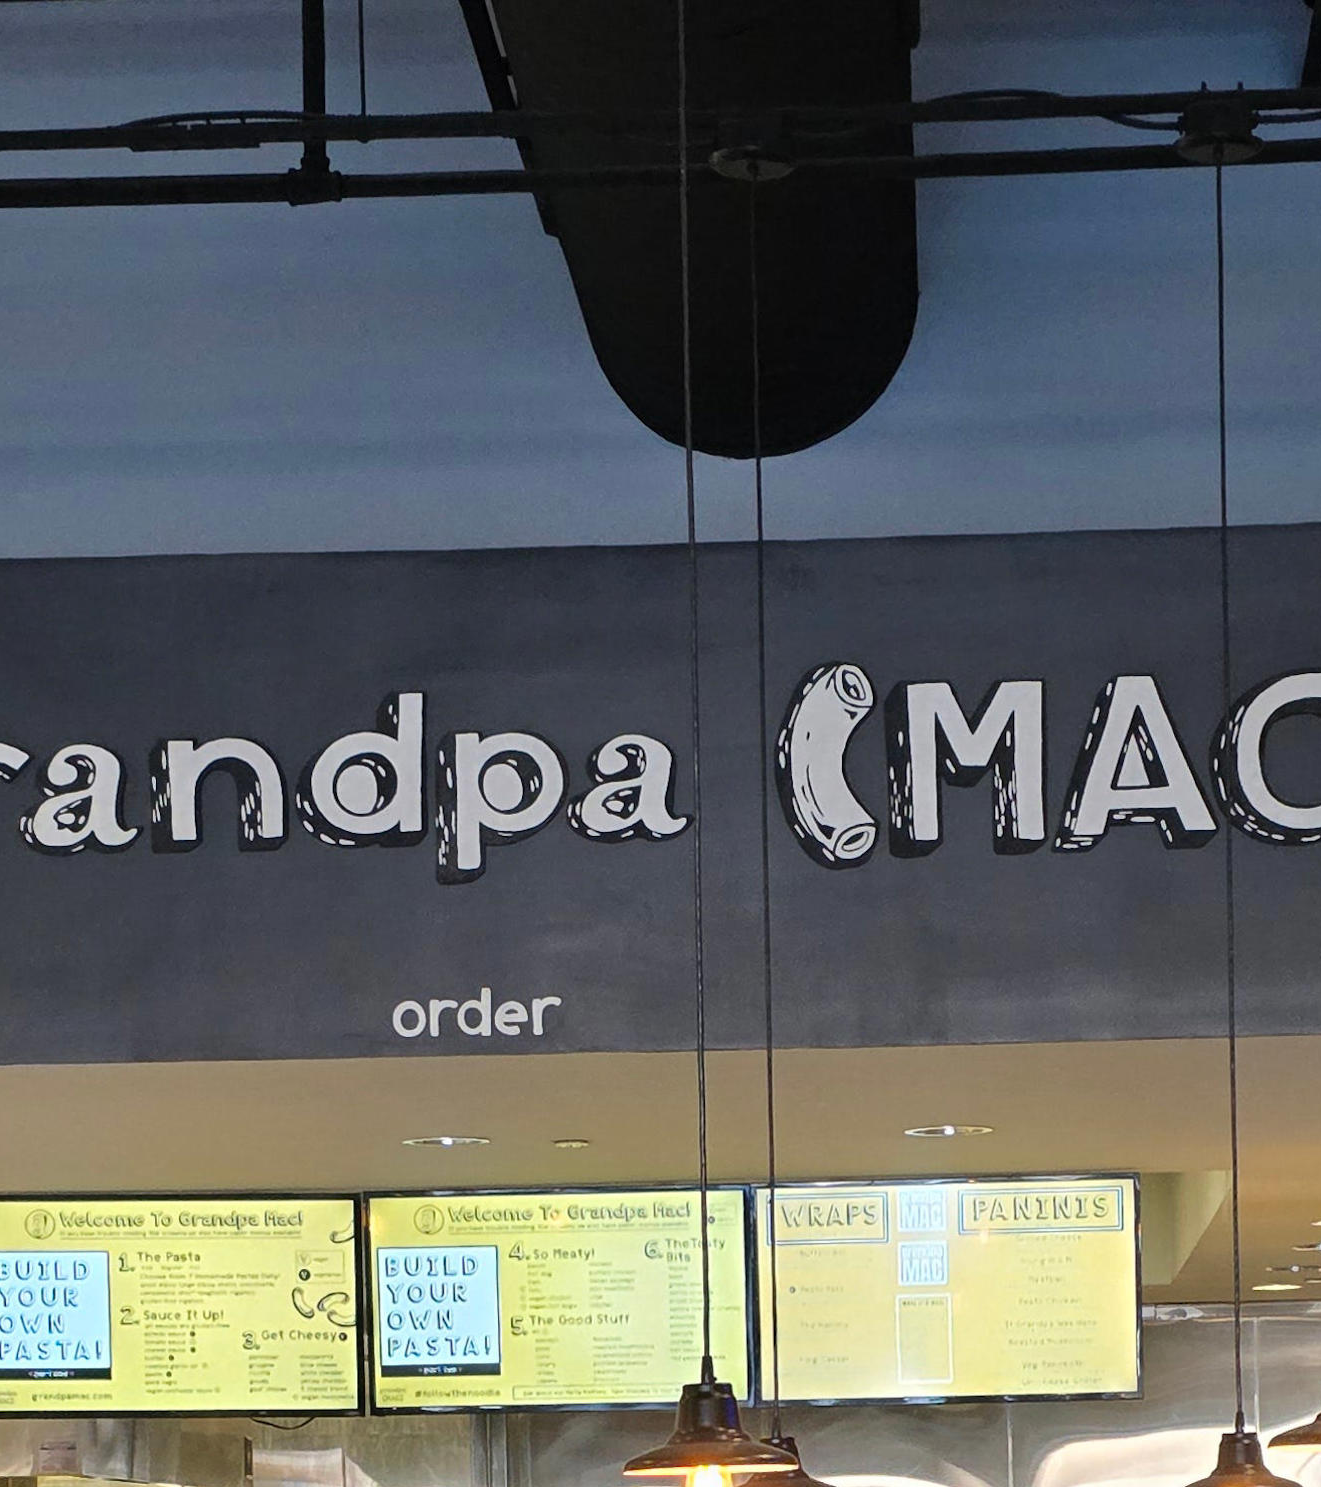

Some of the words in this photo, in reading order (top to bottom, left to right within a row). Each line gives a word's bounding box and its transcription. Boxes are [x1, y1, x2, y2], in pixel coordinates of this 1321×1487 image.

[392, 988, 563, 1039] order
[447, 1204, 533, 1223] Welcome
[567, 1204, 648, 1222] Grandpa
[781, 1202, 878, 1228] WRAPS
[972, 1195, 1109, 1221] PANINIS
[59, 1211, 146, 1228] Welcome
[151, 1212, 174, 1227] To
[178, 1211, 260, 1230] Grandpa
[665, 1239, 689, 1249] The
[138, 1252, 161, 1262] The
[166, 1252, 201, 1263] Pasta
[533, 1248, 548, 1259] So
[553, 1248, 595, 1261] Meaty!
[385, 1255, 479, 1277] BUILD
[902, 1258, 944, 1282] MAC
[386, 1282, 468, 1304] YOUR
[143, 1310, 181, 1320] Sauce
[187, 1310, 198, 1320] It
[203, 1310, 225, 1322] Up!
[387, 1309, 454, 1330] OWN
[529, 1315, 552, 1326] The
[559, 1315, 593, 1325] Good
[597, 1314, 631, 1325] Stuff
[261, 1330, 284, 1340] Get
[289, 1330, 337, 1342] Cheesy
[0, 1340, 102, 1360] PASTA!
[388, 1335, 491, 1358] PASTA!
